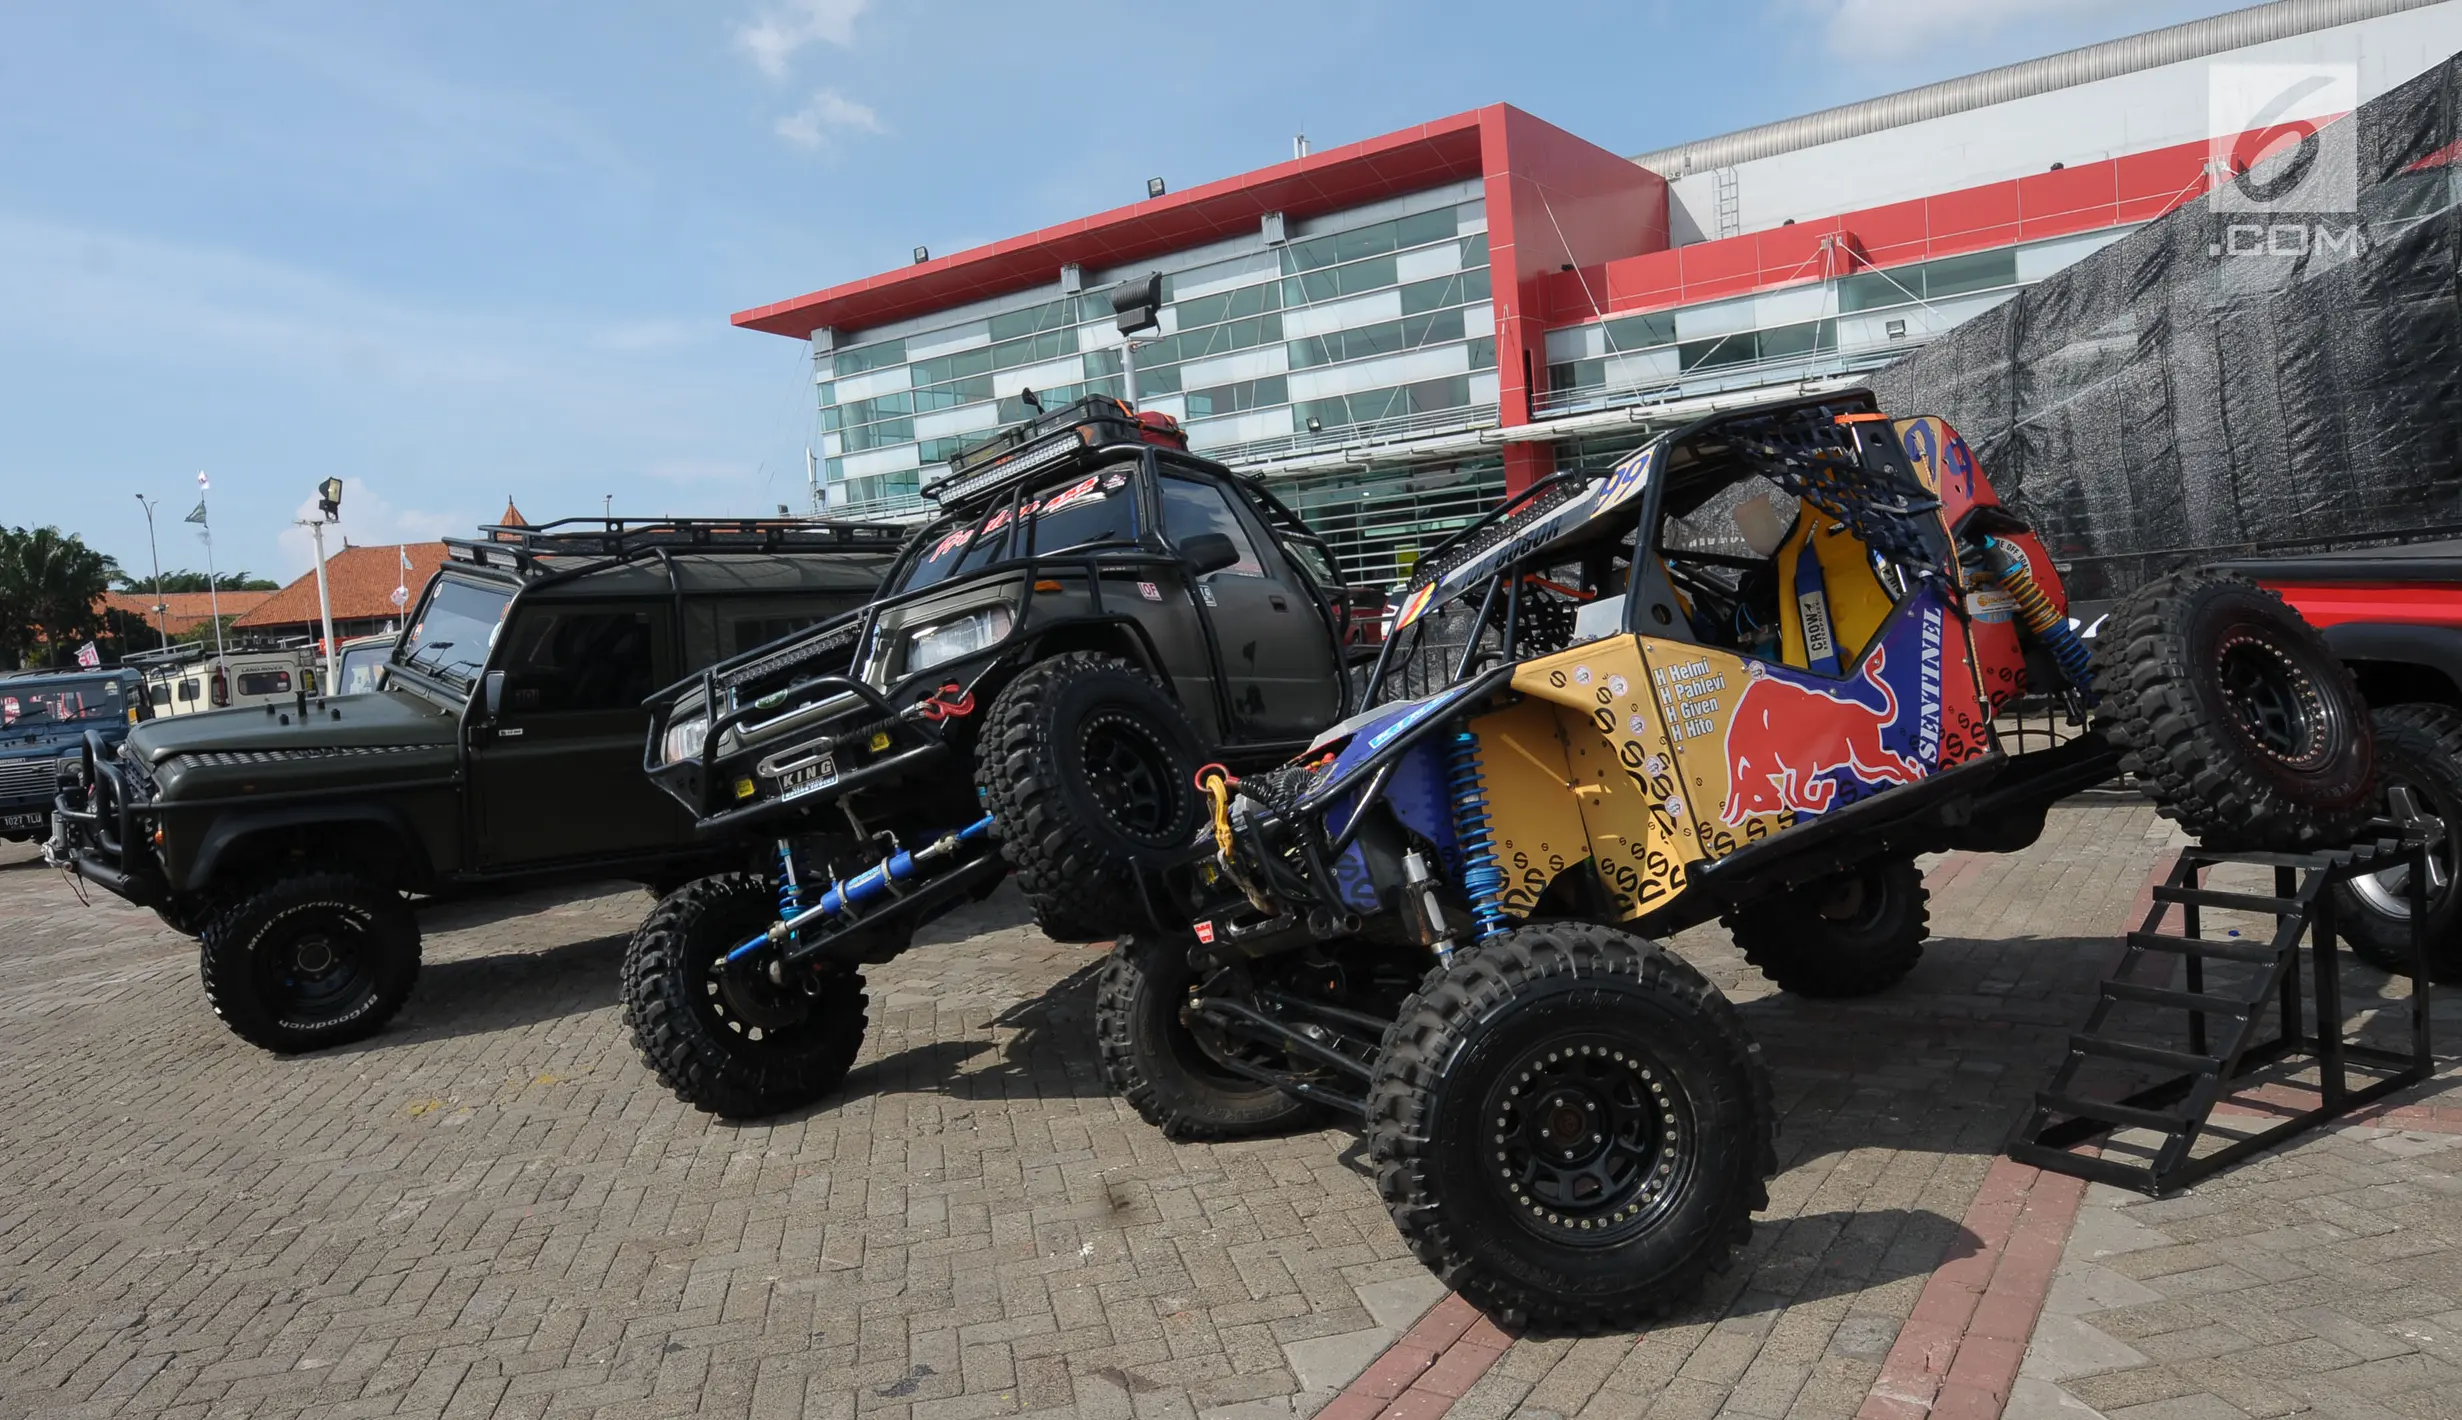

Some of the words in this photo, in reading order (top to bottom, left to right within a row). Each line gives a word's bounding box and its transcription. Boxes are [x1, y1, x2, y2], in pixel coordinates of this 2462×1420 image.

[2006, 543, 2019, 556] OFF
[1806, 612, 1823, 652] CROW
[1654, 668, 1667, 686] H
[1668, 656, 1710, 682] Helmi
[1919, 607, 1942, 764] SENTINEL
[1660, 687, 1673, 705] H
[1674, 672, 1726, 701] Pahlevi
[1665, 705, 1678, 723] H
[1680, 698, 1719, 719] Given
[1671, 724, 1683, 743] H
[1685, 718, 1714, 739] Hito
[783, 760, 833, 788] KING
[348, 904, 373, 921] T/A
[279, 994, 378, 1030] BFGoodrich
